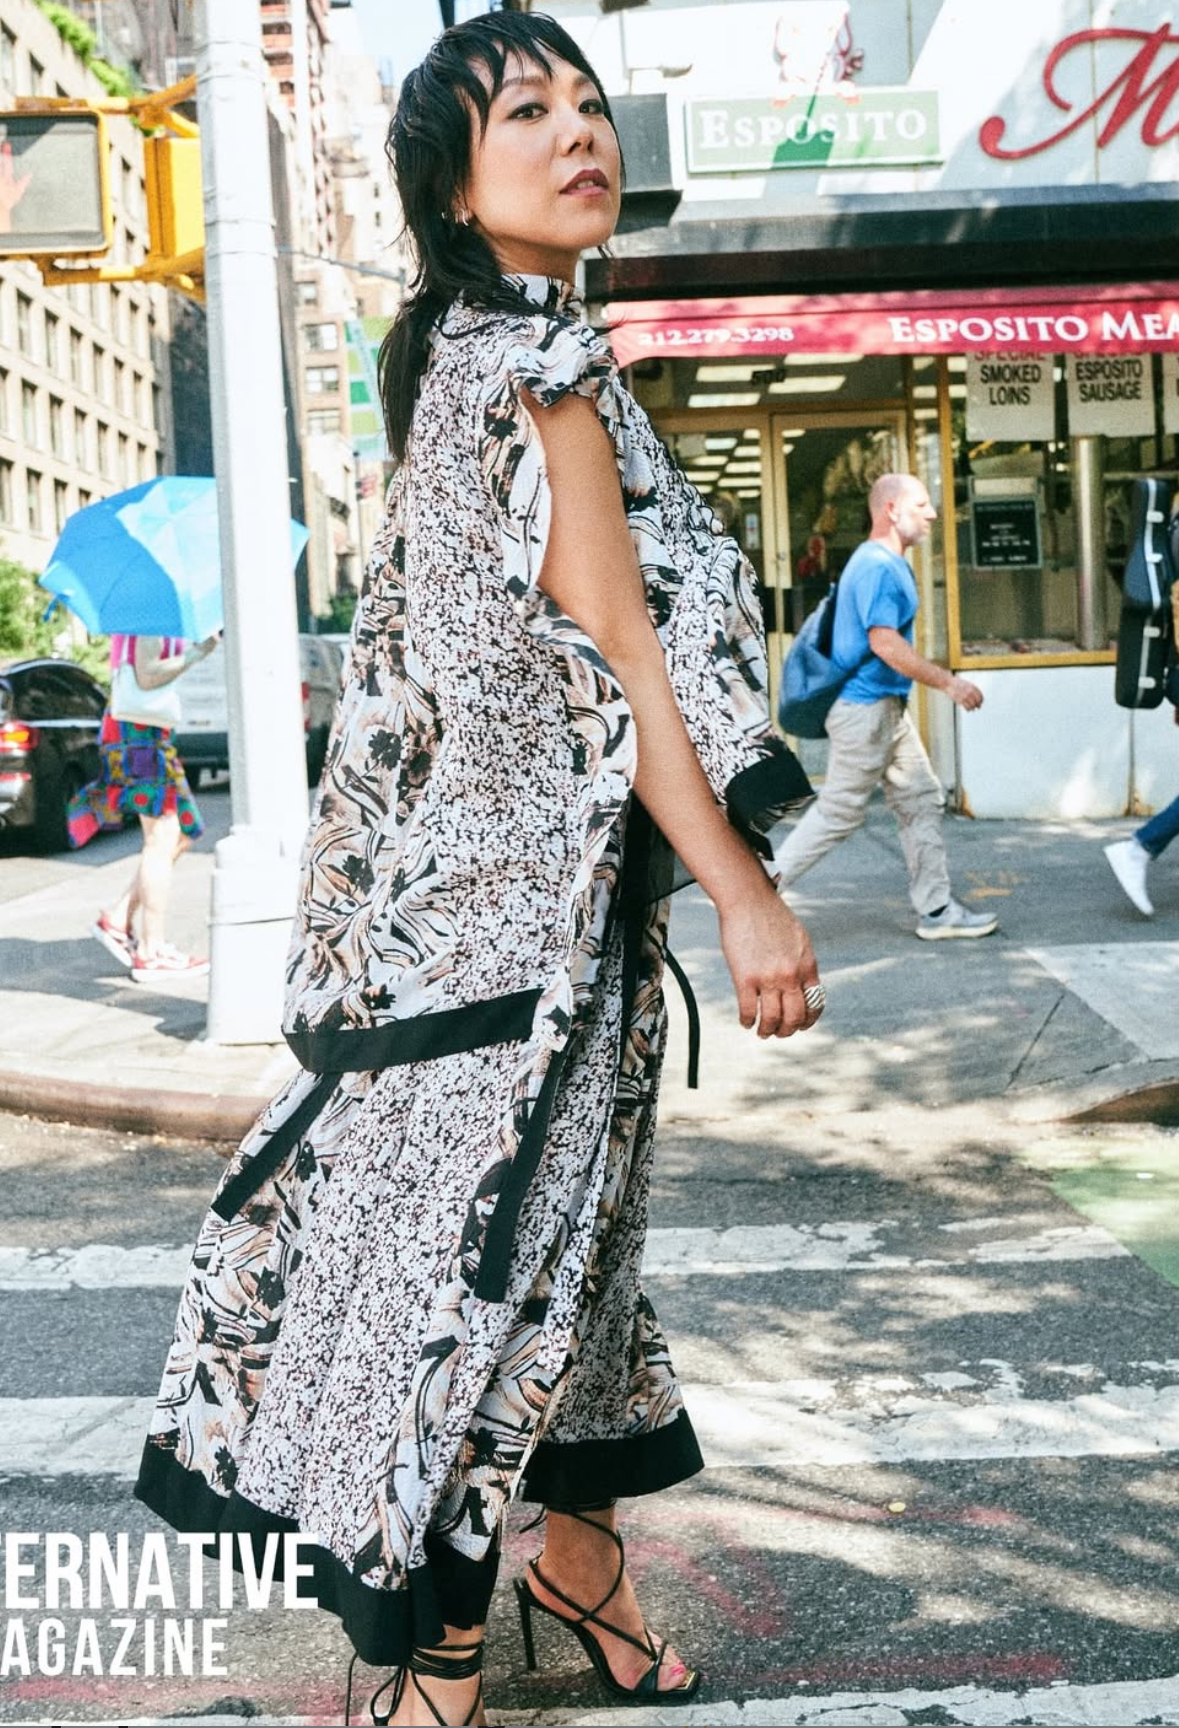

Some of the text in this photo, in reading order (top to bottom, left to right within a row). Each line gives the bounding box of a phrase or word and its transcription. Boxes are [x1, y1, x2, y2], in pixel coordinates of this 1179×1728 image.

[700, 109, 927, 147] ESPOSITO
[637, 327, 794, 346] 212.279.3298
[888, 311, 1179, 342] ESPOSITO MEA
[980, 363, 1042, 384] SMOKED
[1076, 359, 1143, 381] ESPOSITO
[989, 386, 1030, 405] LOINS
[1079, 381, 1141, 402] SAUSAGE
